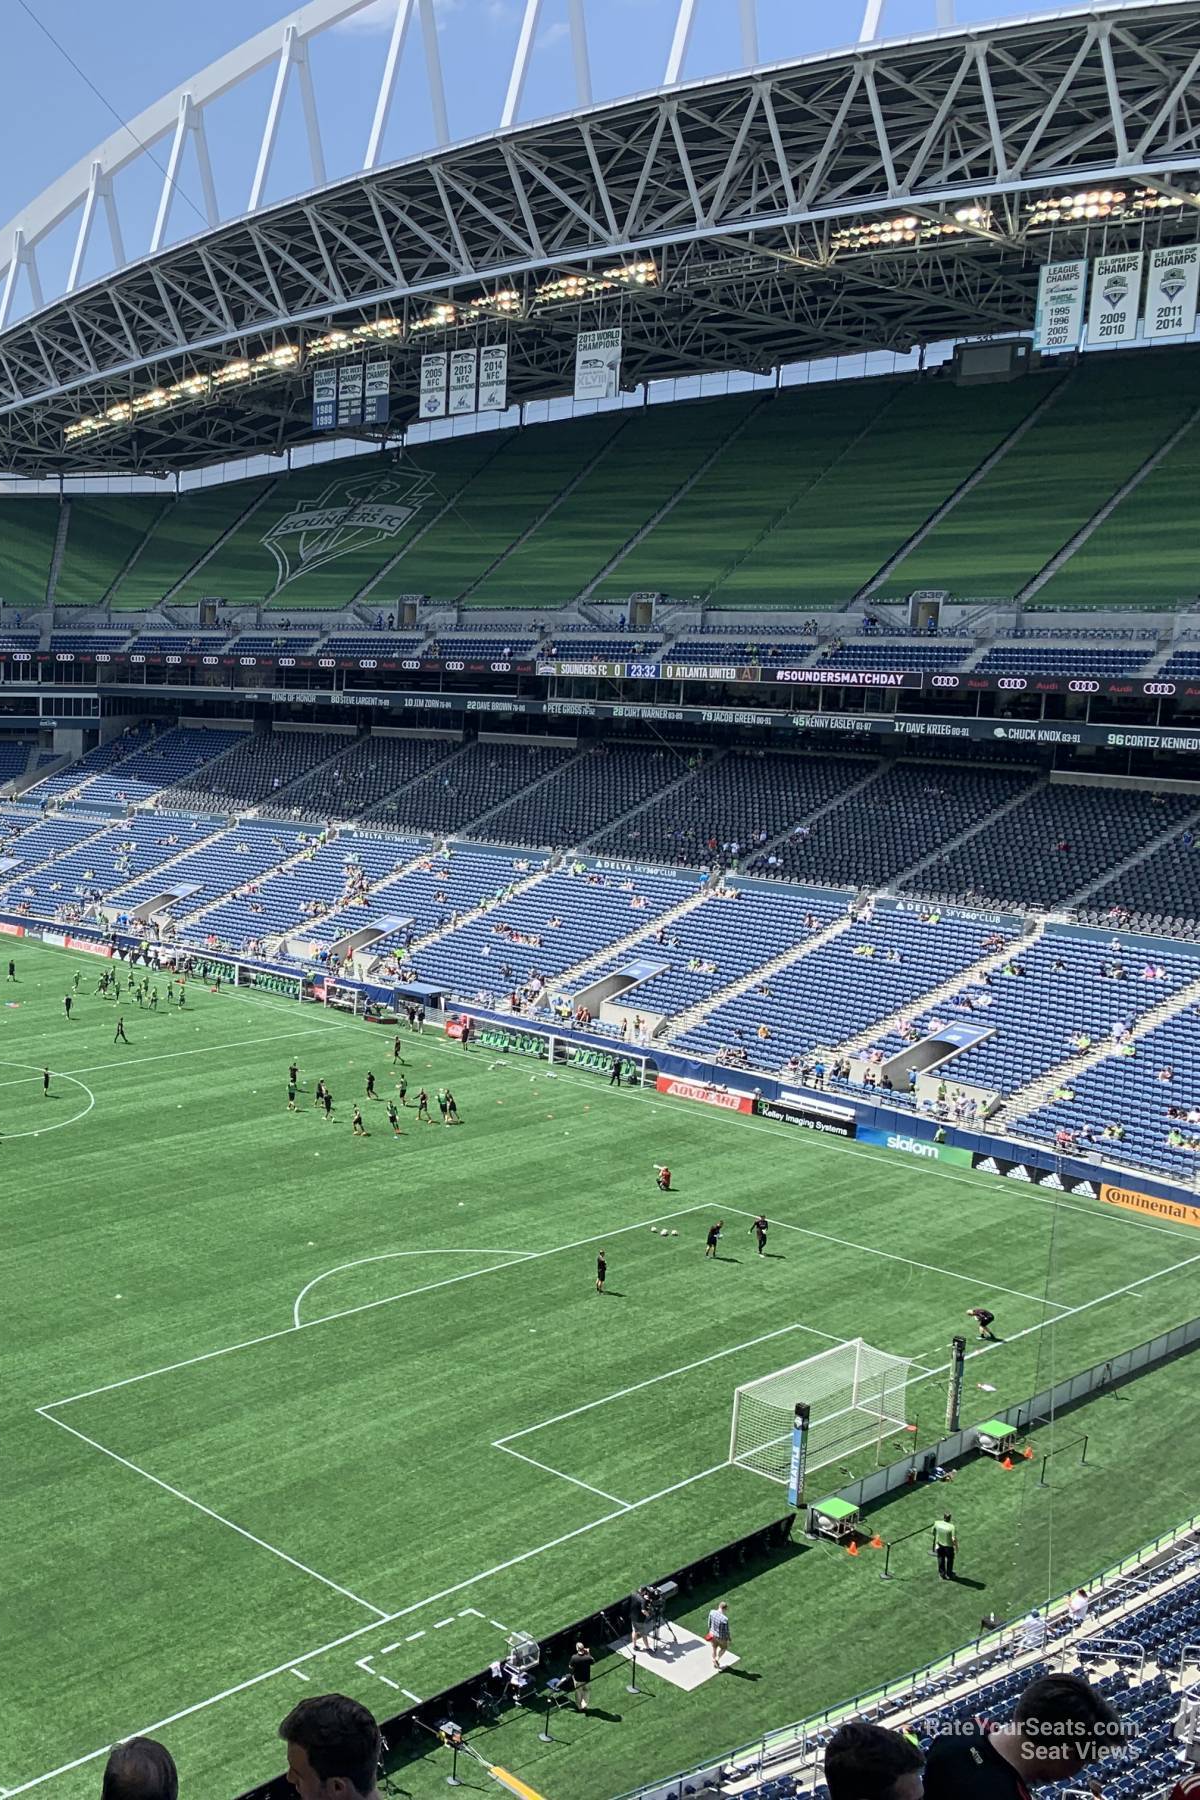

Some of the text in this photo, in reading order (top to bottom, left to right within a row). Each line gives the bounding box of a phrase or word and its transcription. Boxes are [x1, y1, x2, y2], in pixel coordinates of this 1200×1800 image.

[1154, 254, 1196, 268] CHAMPS
[1049, 264, 1078, 275] LEAGUE
[1098, 262, 1138, 275] CHAMPS
[1046, 272, 1080, 283] CHAMPS
[1050, 306, 1070, 316] 1995
[1157, 305, 1182, 318] 2011
[1049, 316, 1069, 326] 1996
[1100, 312, 1126, 324] 2009
[1156, 318, 1182, 330] 2014
[1048, 326, 1068, 336] 2005
[1099, 324, 1125, 336] 2010
[578, 330, 620, 343] 2013 WORLD
[1046, 336, 1068, 345] 2007
[578, 339, 619, 352] CHAMPIONS
[454, 365, 472, 375] 2013
[484, 361, 502, 372] 2014
[340, 373, 362, 382] CHAMPS
[367, 368, 389, 378] CHAMPS
[424, 368, 443, 378] 2005
[486, 371, 500, 380] NFC
[315, 376, 335, 385] CHAMPS
[427, 378, 440, 386] NFC
[456, 375, 469, 384] NFC
[450, 383, 475, 391] CHAMPIONS
[280, 513, 400, 533] SOUNDERS FC
[561, 664, 736, 679] SOUNDERS FC 0 23:32 0 ATLANTA UNITED
[776, 670, 904, 685] #SOUNDERSMATCHDAY
[968, 679, 988, 688] Audi
[1036, 681, 1058, 690] Audi
[1109, 684, 1132, 693] Audi
[272, 693, 316, 703] RING OF HONOR
[331, 696, 377, 705] 80 STEVE LARGENT
[413, 699, 424, 707] JIM
[424, 700, 440, 708] ZORN
[467, 701, 512, 711] 22 DAVE BROWN
[547, 704, 582, 714] PETE GROSS
[613, 707, 667, 719] 28 CURT WARNER
[702, 711, 756, 724] 79 JACOB GREEN
[793, 717, 805, 727] 45
[806, 718, 829, 729] KENNY
[830, 719, 856, 730] EASLEY
[894, 722, 905, 732] 17
[906, 723, 925, 733] DAVE
[927, 724, 951, 735] KRIEG
[1008, 729, 1080, 743] CHUCK KNOX 83-91
[1107, 734, 1159, 748] 96 CORTEZ
[160, 810, 180, 818] DELTA
[359, 832, 382, 840] DELTA
[604, 862, 631, 871] DELTA
[907, 903, 941, 916] DELTA
[667, 1082, 741, 1109] ADVOCARE
[762, 1108, 848, 1136] Kelley Imaging Systems
[887, 1134, 940, 1158] slalom
[1106, 1188, 1187, 1219] Continental
